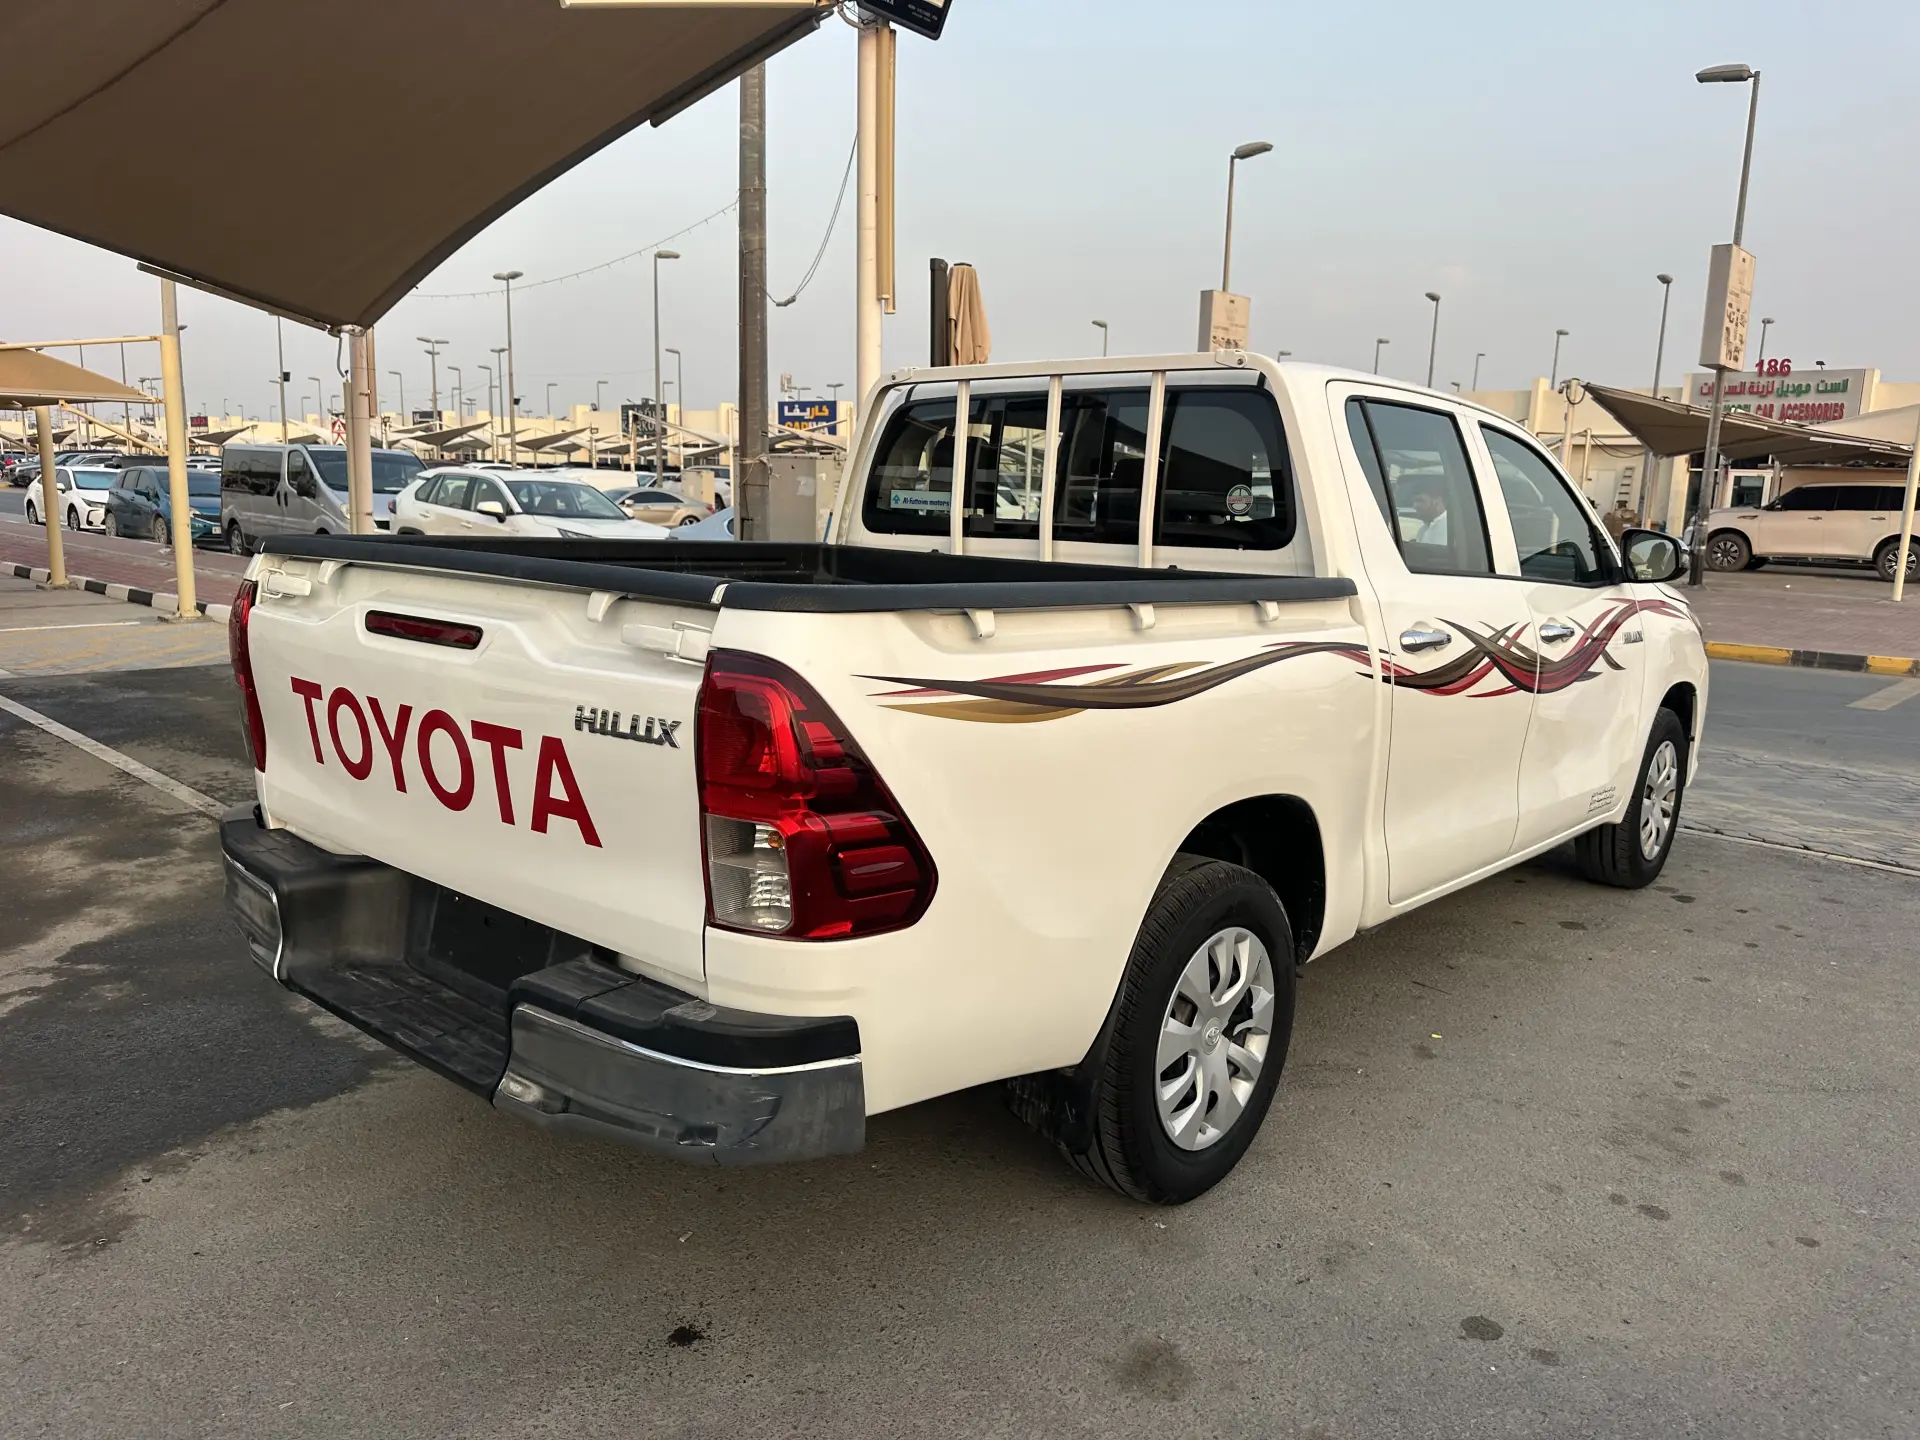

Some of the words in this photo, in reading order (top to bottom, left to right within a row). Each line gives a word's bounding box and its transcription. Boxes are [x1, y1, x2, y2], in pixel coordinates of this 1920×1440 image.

[1755, 358, 1792, 377] 186
[1756, 403, 1775, 419] CAR
[1779, 402, 1846, 421] ACCESSORIES
[574, 704, 682, 749] HILUX
[290, 676, 603, 848] TOYOTA
